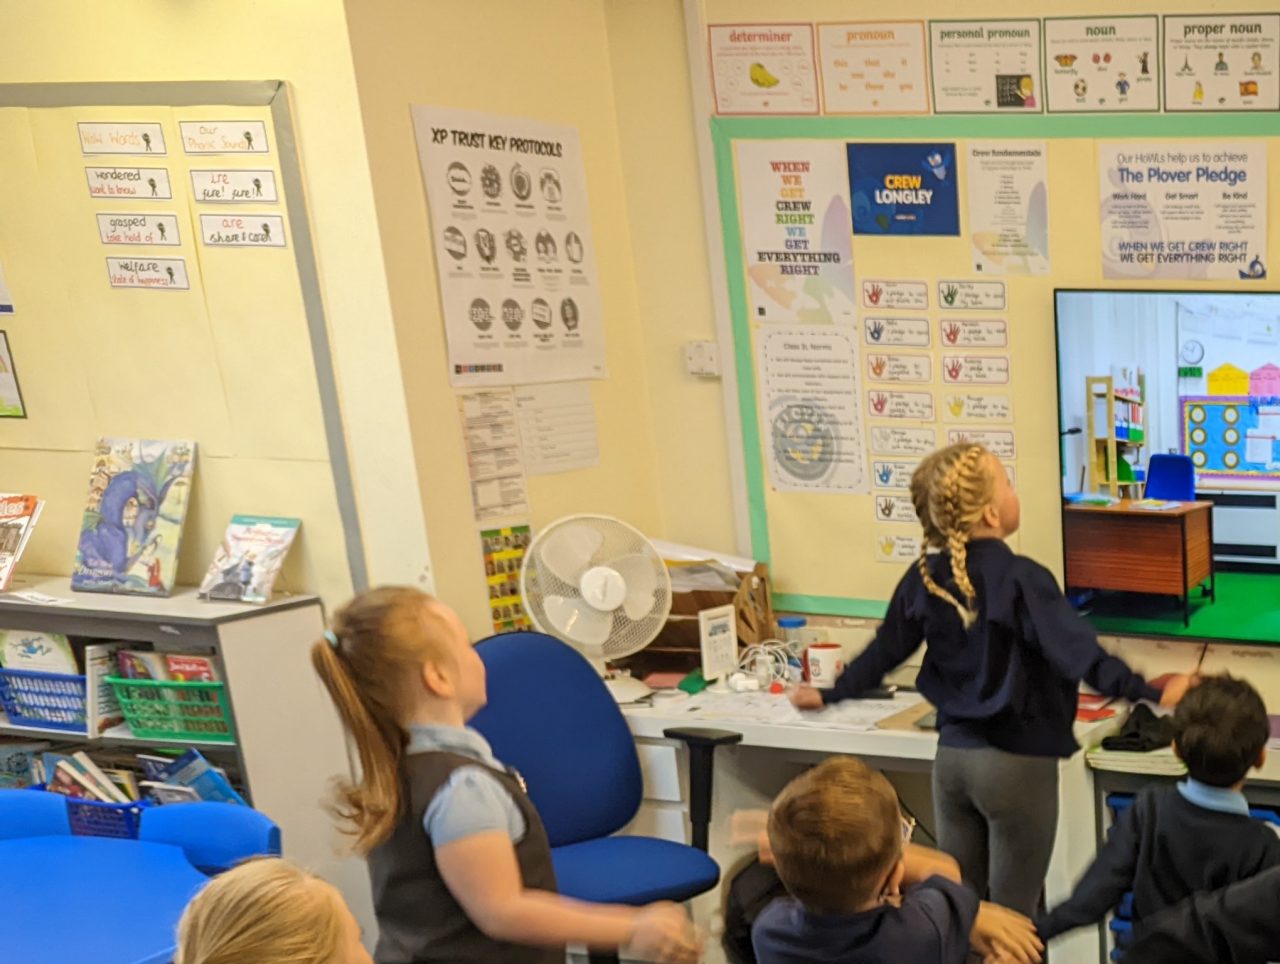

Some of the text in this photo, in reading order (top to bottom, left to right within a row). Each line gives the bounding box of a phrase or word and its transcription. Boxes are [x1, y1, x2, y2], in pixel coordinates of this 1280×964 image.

[730, 30, 792, 43] determiner
[940, 28, 1030, 42] personal pronoun
[1086, 26, 1116, 37] noun
[1184, 23, 1262, 38] proper noun
[847, 30, 895, 44] pronoun
[431, 127, 563, 158] XP TRUST KEY PROTOCOLS
[1117, 153, 1133, 163] Our
[1167, 152, 1187, 165] help
[1189, 155, 1200, 163] us
[1202, 153, 1211, 163] to
[1213, 152, 1248, 163] achieve
[769, 161, 811, 173] WHEN
[95, 168, 141, 181] wondered
[781, 174, 802, 186] WE
[1118, 166, 1247, 186] The Plover Pledge
[884, 174, 922, 189] CREW
[780, 187, 805, 199] GET
[874, 189, 934, 205] LONGLEY
[1222, 191, 1248, 200] Be Kind
[776, 200, 812, 212] CREW
[109, 216, 146, 233] grasped
[222, 218, 245, 229] are
[775, 213, 815, 225] RIGHT
[785, 226, 807, 237] WE
[785, 239, 809, 250] GET
[1118, 241, 1248, 252] WHEN WE GET CREW RIGHT
[757, 251, 841, 264] EVERYTHING
[1120, 253, 1247, 264] WE GET EVERYTHING RIGHT
[118, 260, 160, 274] welfare
[780, 264, 820, 276] RIGHT
